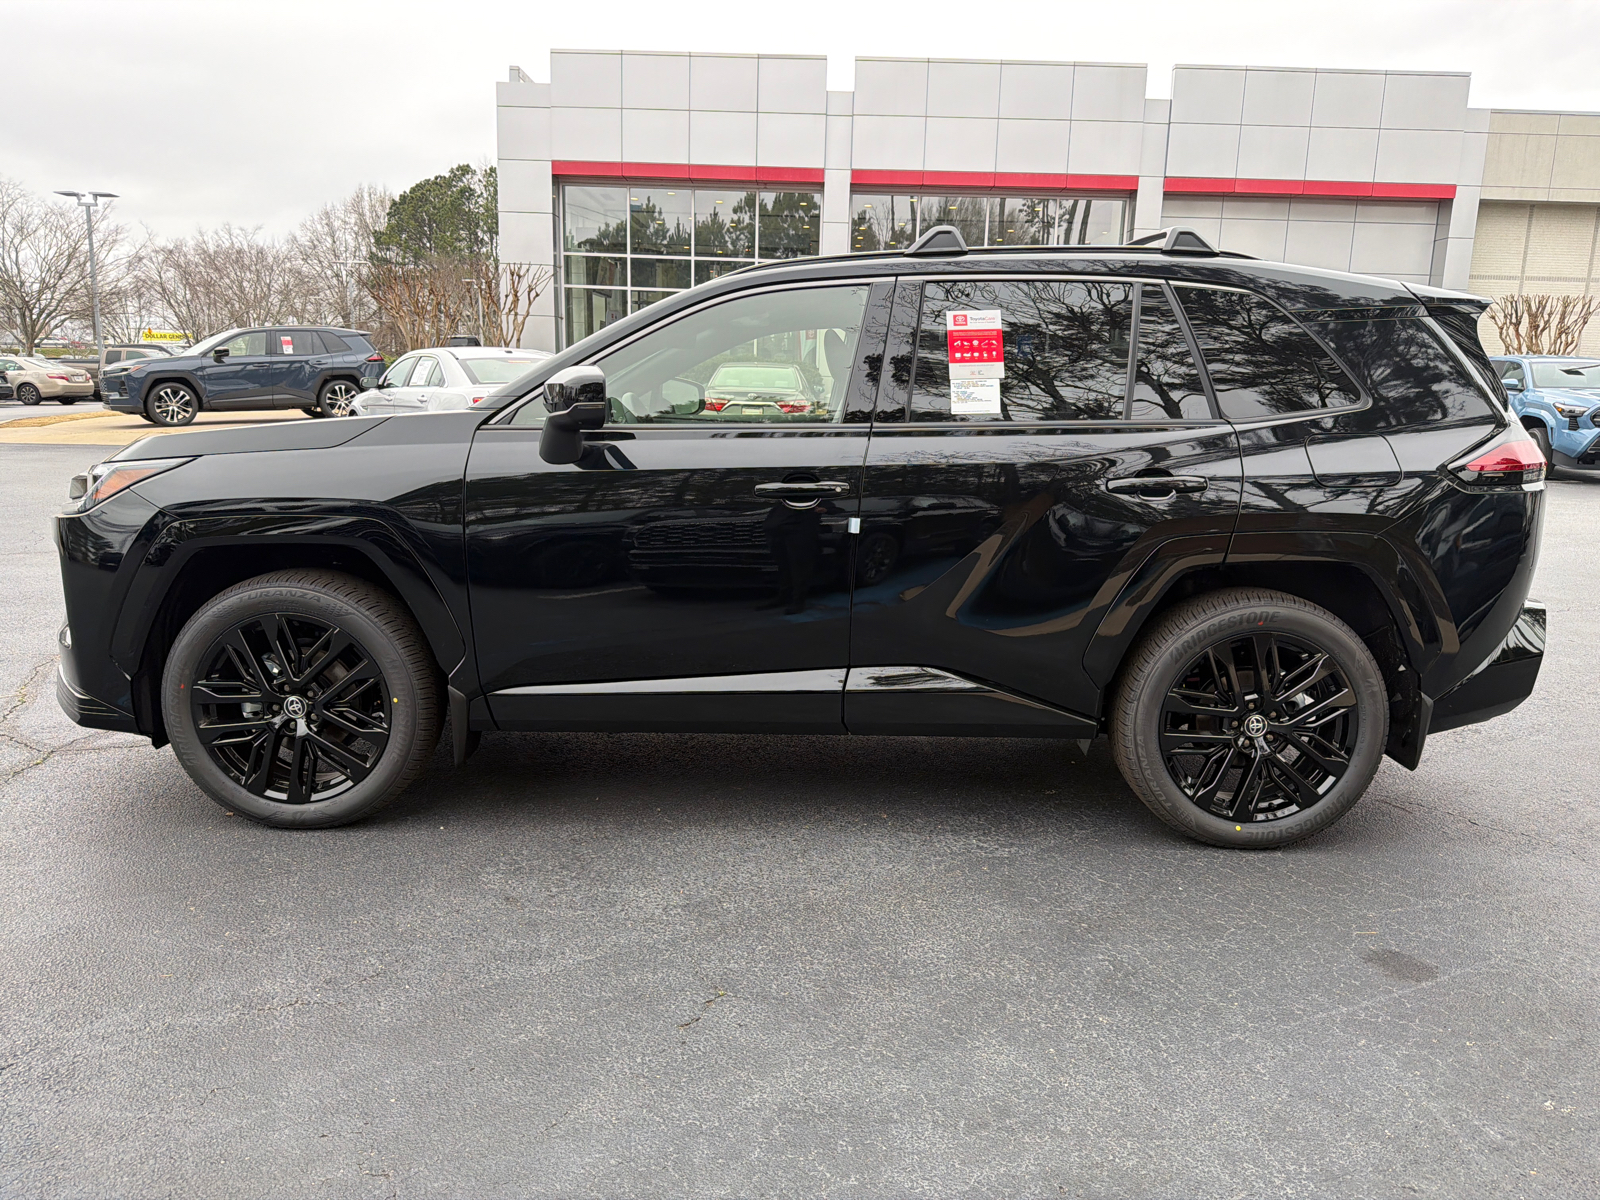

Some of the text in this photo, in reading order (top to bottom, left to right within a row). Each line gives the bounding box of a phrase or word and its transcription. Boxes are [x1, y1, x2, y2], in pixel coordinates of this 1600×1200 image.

[236, 589, 322, 604] TURANZA
[1168, 610, 1282, 666] BRIDGESTONE
[1136, 735, 1172, 810] TURANZA
[1245, 791, 1352, 843] BRIDGESTONE
